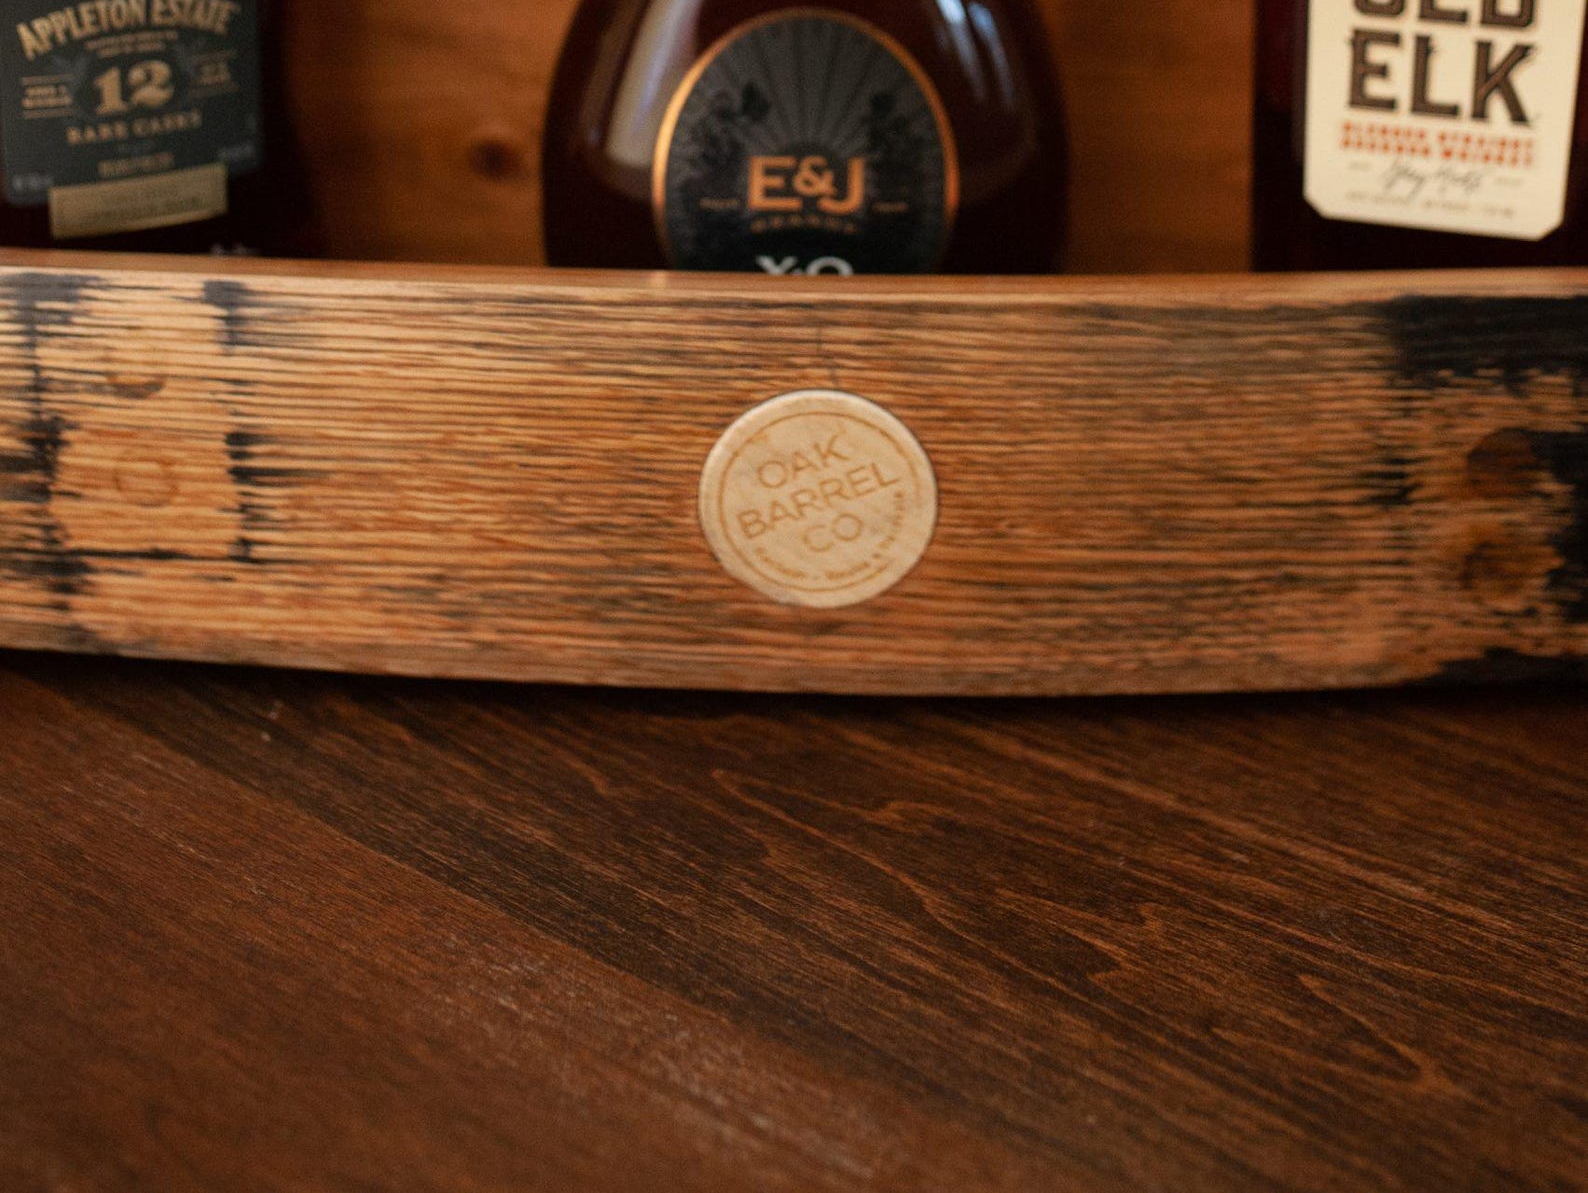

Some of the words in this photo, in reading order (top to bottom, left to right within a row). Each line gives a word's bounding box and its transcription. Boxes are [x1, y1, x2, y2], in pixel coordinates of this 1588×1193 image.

[94, 60, 175, 116] 12
[1348, 27, 1538, 128] ELK
[748, 156, 864, 215] E&J
[757, 433, 850, 488] OAK
[736, 462, 899, 540] BARREL
